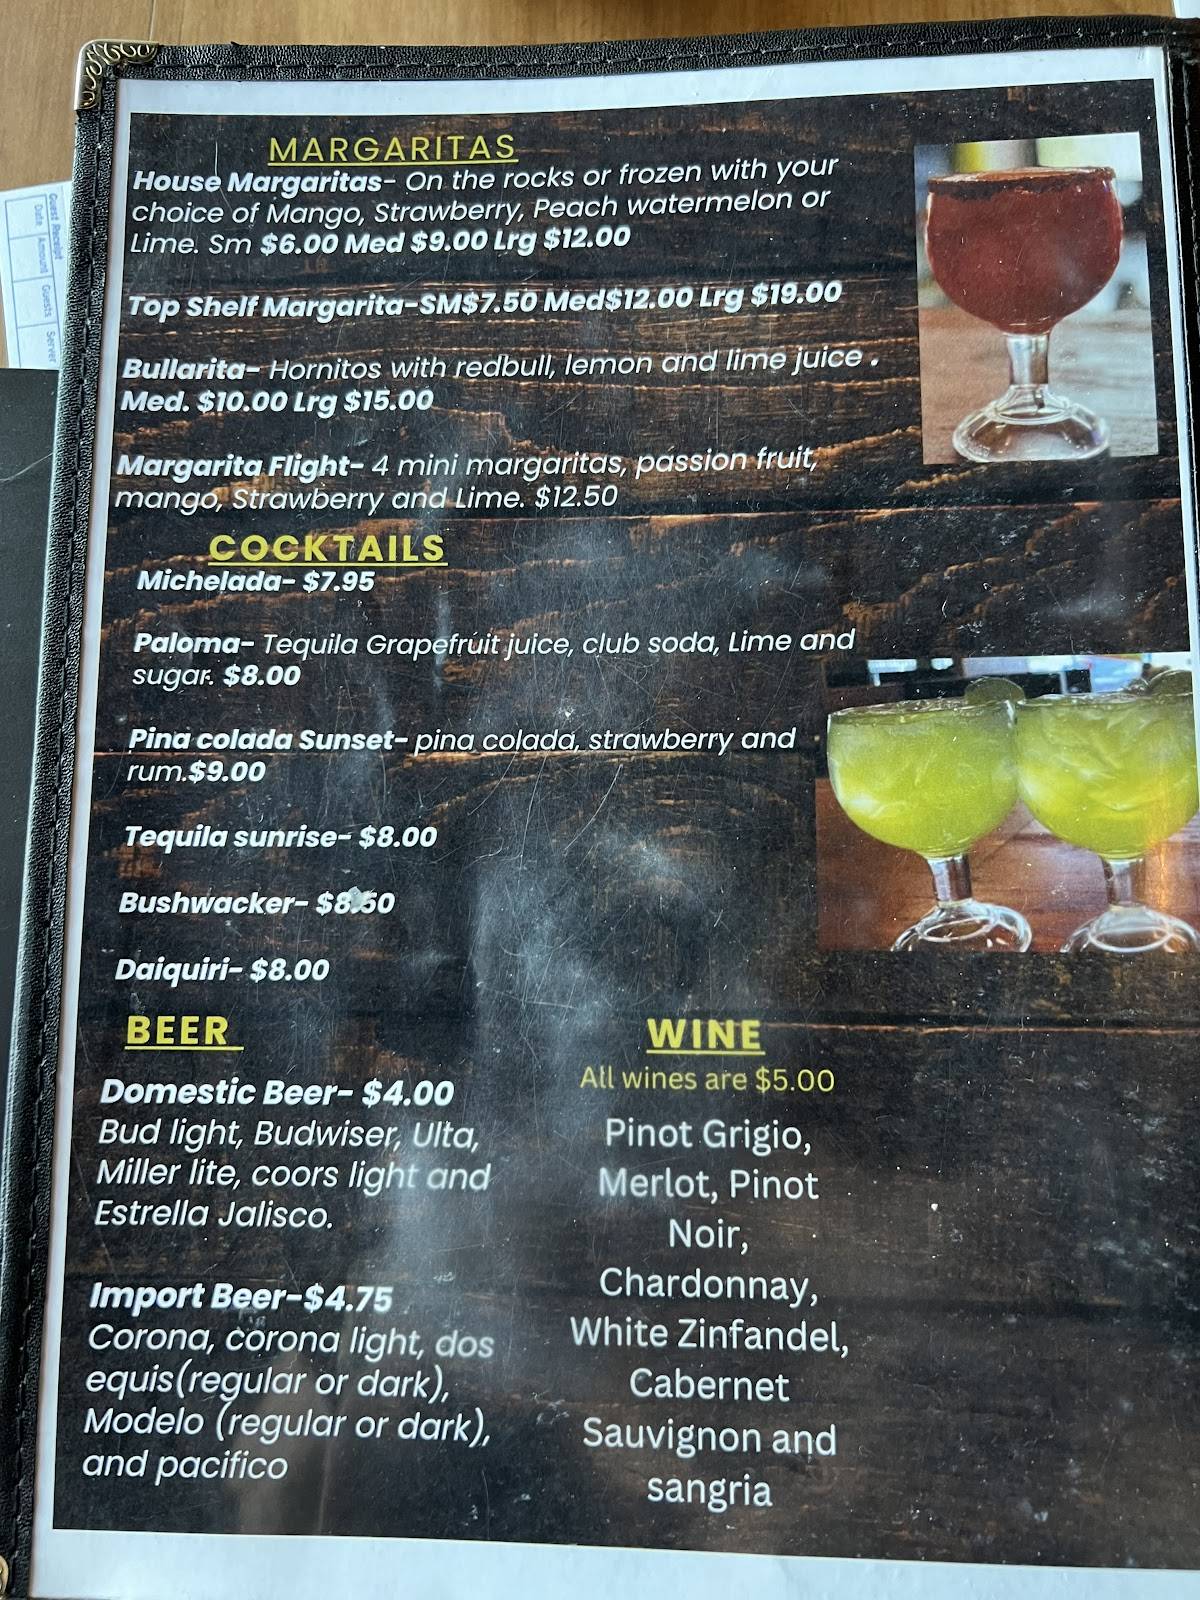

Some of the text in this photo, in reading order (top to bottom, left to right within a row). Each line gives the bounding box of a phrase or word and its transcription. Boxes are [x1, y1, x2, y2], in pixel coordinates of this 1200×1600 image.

[269, 134, 516, 161] MARGARITAS
[133, 158, 839, 198] House Margaritas- On the rocks or frozen with your
[34, 205, 43, 226] Date
[132, 188, 831, 229] choice of Mango, Strawberry, Peach watermelon or
[48, 193, 64, 260] Guest Receipt
[130, 226, 631, 256] Lime. Sm $6.00 Med $9.00 Lrg $12.00
[38, 237, 48, 274] Amount
[41, 284, 52, 318] Guests
[129, 281, 842, 323] Top Shelf Margarita-SM$7.50 Med$12.00 Lrg $19.00
[46, 331, 57, 363] Server
[122, 358, 260, 380] Bullarita-
[269, 359, 381, 380] Hornitos
[391, 358, 446, 378] with
[456, 354, 555, 378] redbull,
[565, 353, 652, 375] lemon
[662, 350, 718, 372] and
[726, 348, 786, 370] lime
[792, 346, 863, 375] juice
[120, 389, 433, 418] Med. $10.00 Lrg $15.00
[117, 446, 818, 484] Margarita Flight- 4 mini margaritas, passion fruit,
[115, 484, 618, 516] mango, Strawberry and Lime. $12.50
[209, 534, 445, 561] COCKTAILS
[137, 569, 375, 593] Michelada- $7.95
[133, 628, 855, 661] Paloma- Tequila Grapefruit juice, club soda, Lime and
[132, 664, 301, 691] sugar. $8.00
[128, 728, 796, 758] Pina colada Sunset- pina colada, strawberry and
[127, 760, 266, 784] rum.$9.00
[125, 824, 438, 853] Tequila sunrise- $8.00
[119, 892, 308, 914] Bushwacker-
[115, 957, 329, 987] Daiquiri- $8.00
[127, 1016, 229, 1045] BEER
[647, 1019, 761, 1049] WINE
[102, 1078, 454, 1107] Domestic Beer- $4.00
[580, 1066, 834, 1093] All wines are $5.00
[99, 1118, 479, 1153] Bud light, Budwiser, Ulta,
[606, 1117, 811, 1156] Pinot Grigio,
[97, 1159, 491, 1197] Miller lite, coors light and
[599, 1167, 819, 1204] Merlot, Pinot
[94, 1199, 333, 1228] Estrella Jalisco.
[669, 1218, 748, 1254] Noir,
[89, 1282, 393, 1317] Import Beer-$4.75
[600, 1266, 818, 1308] Chardonnay,
[88, 1324, 494, 1363] Corona, corona light, dos
[570, 1316, 849, 1358] White Zinfandel,
[86, 1359, 450, 1403] equis(regular or dark),
[630, 1368, 790, 1401] Cabernet
[83, 1401, 491, 1447] Modelo (regular or dark),
[583, 1417, 836, 1458] Sauvignon and
[82, 1450, 288, 1486] and pacifico
[648, 1474, 773, 1513] sangria
